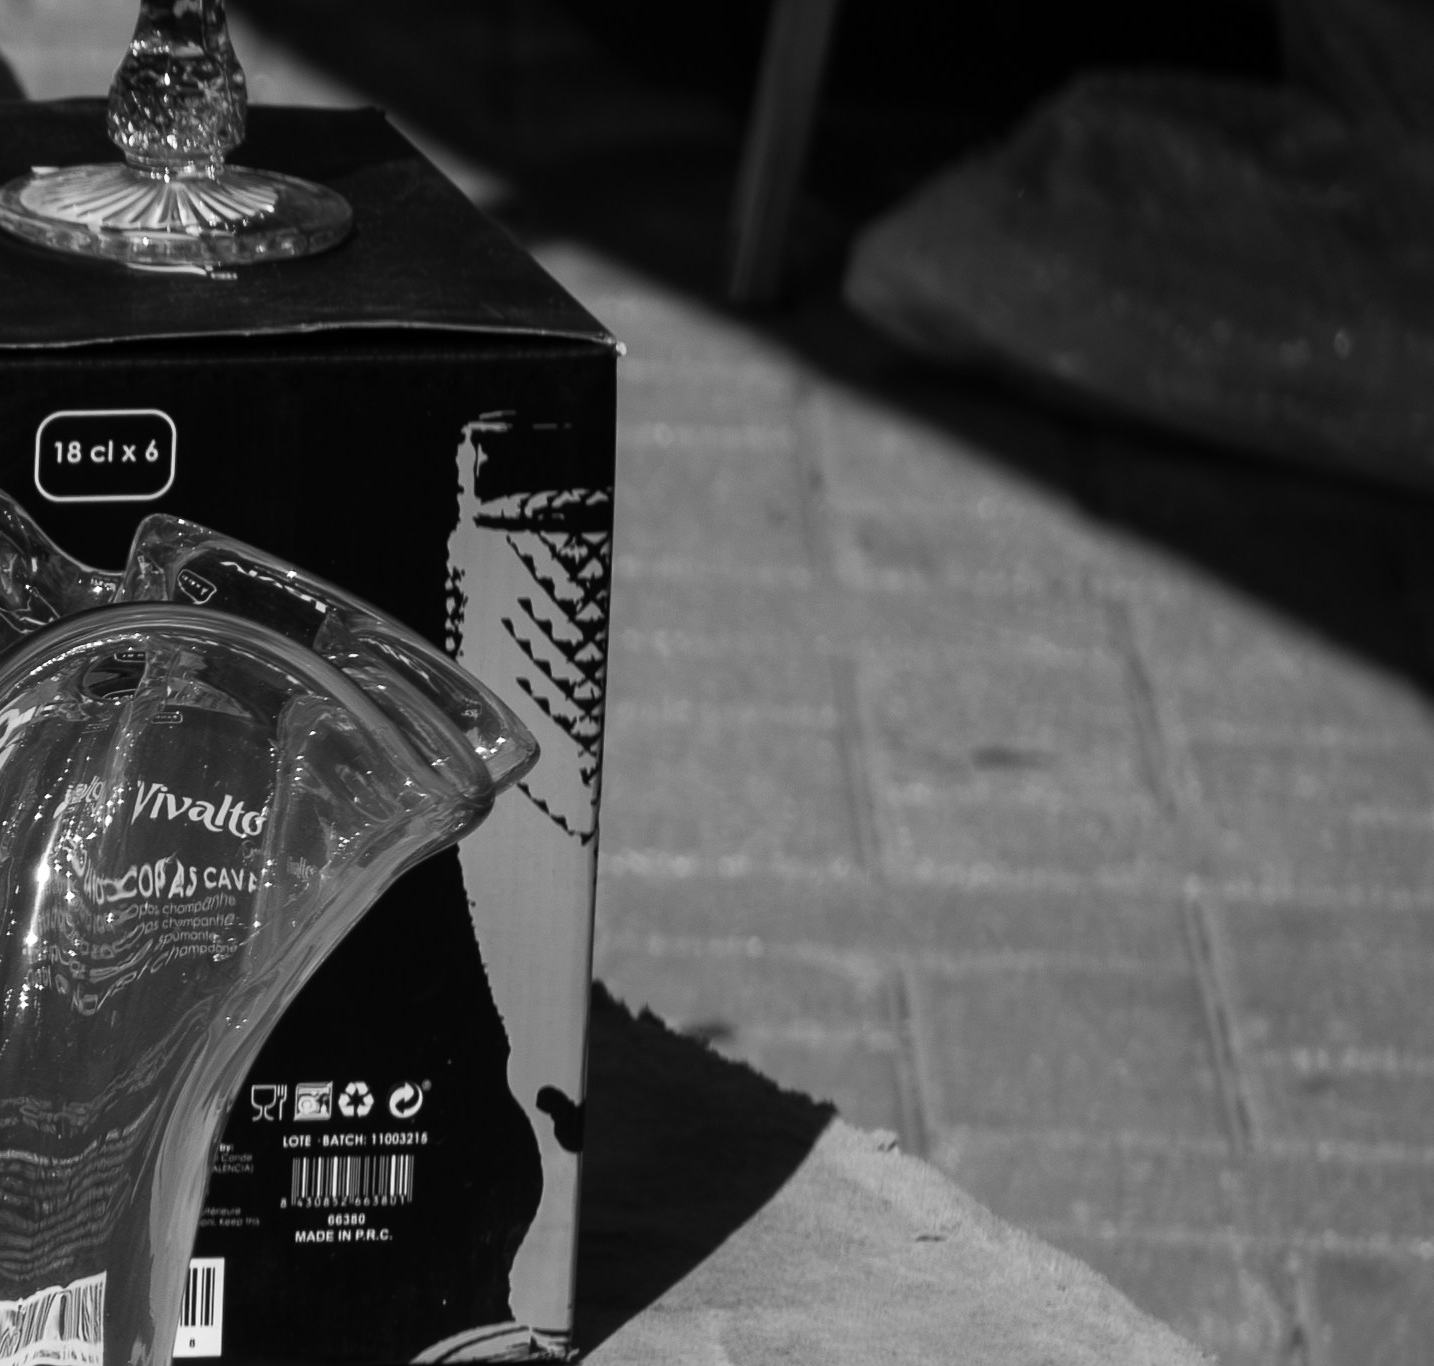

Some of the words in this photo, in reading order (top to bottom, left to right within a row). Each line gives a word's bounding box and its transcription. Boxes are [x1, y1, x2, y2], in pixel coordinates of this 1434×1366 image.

[54, 440, 82, 464] 18
[90, 439, 114, 463] cl
[121, 444, 136, 463] x
[145, 439, 159, 463] 6
[132, 780, 266, 838] Vivalto
[282, 1135, 311, 1149] LOTE
[295, 1230, 334, 1243] MADE
[338, 1230, 352, 1242] IN
